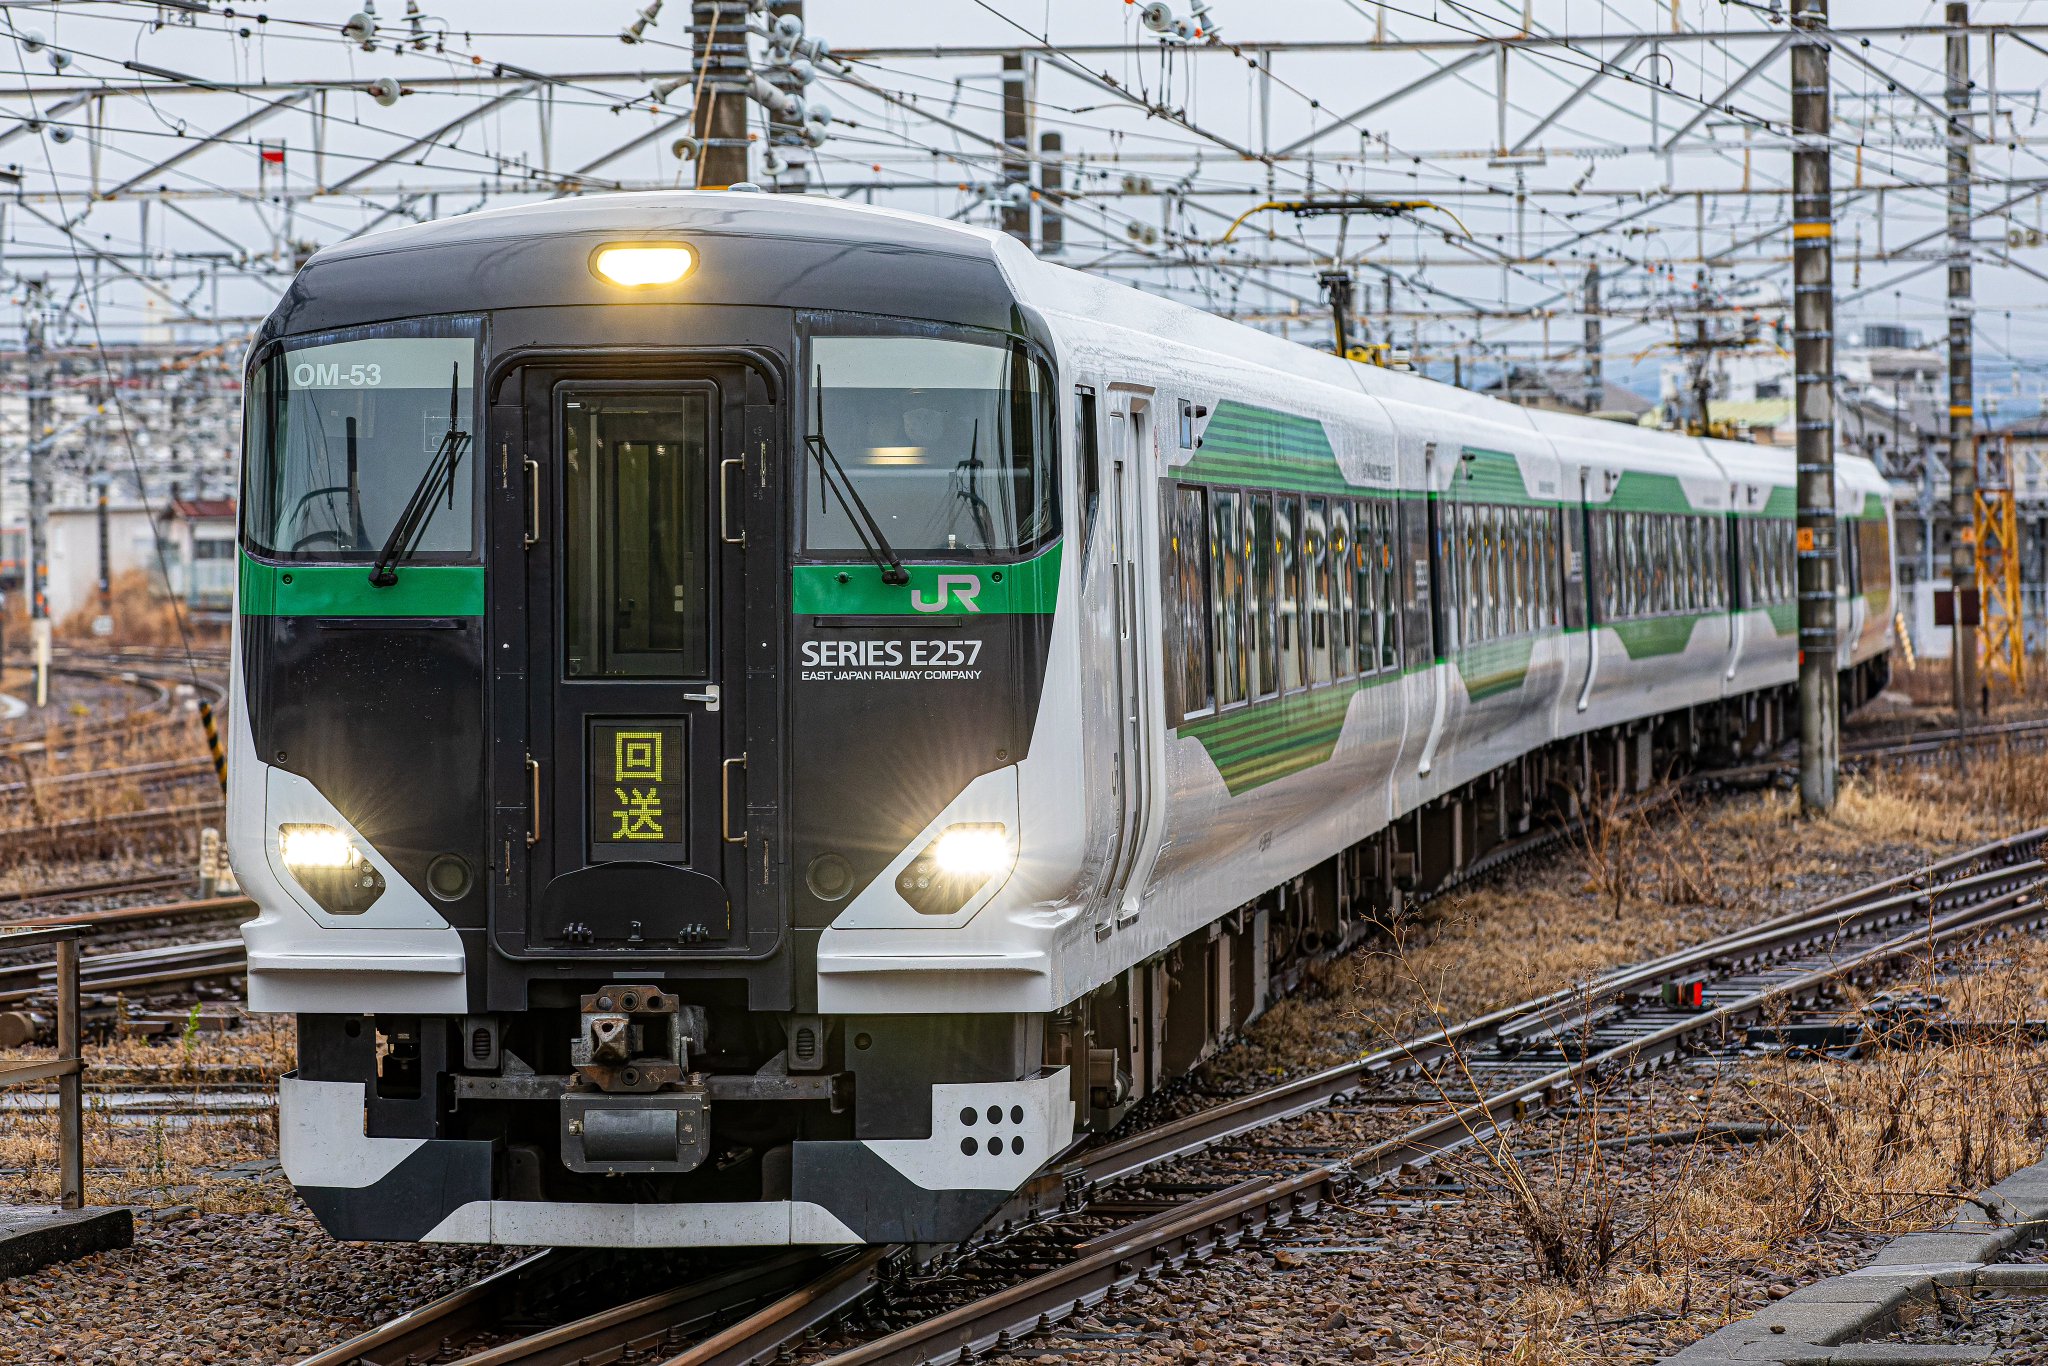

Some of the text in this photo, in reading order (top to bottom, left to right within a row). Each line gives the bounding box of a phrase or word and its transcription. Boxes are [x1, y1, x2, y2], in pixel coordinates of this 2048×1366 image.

[293, 363, 382, 387] OM-53
[911, 574, 981, 613] JR
[801, 640, 982, 667] SERIES E257
[801, 670, 982, 681] EAST JAPAN RAILWAY COMPANY
[612, 732, 664, 839] 回送
